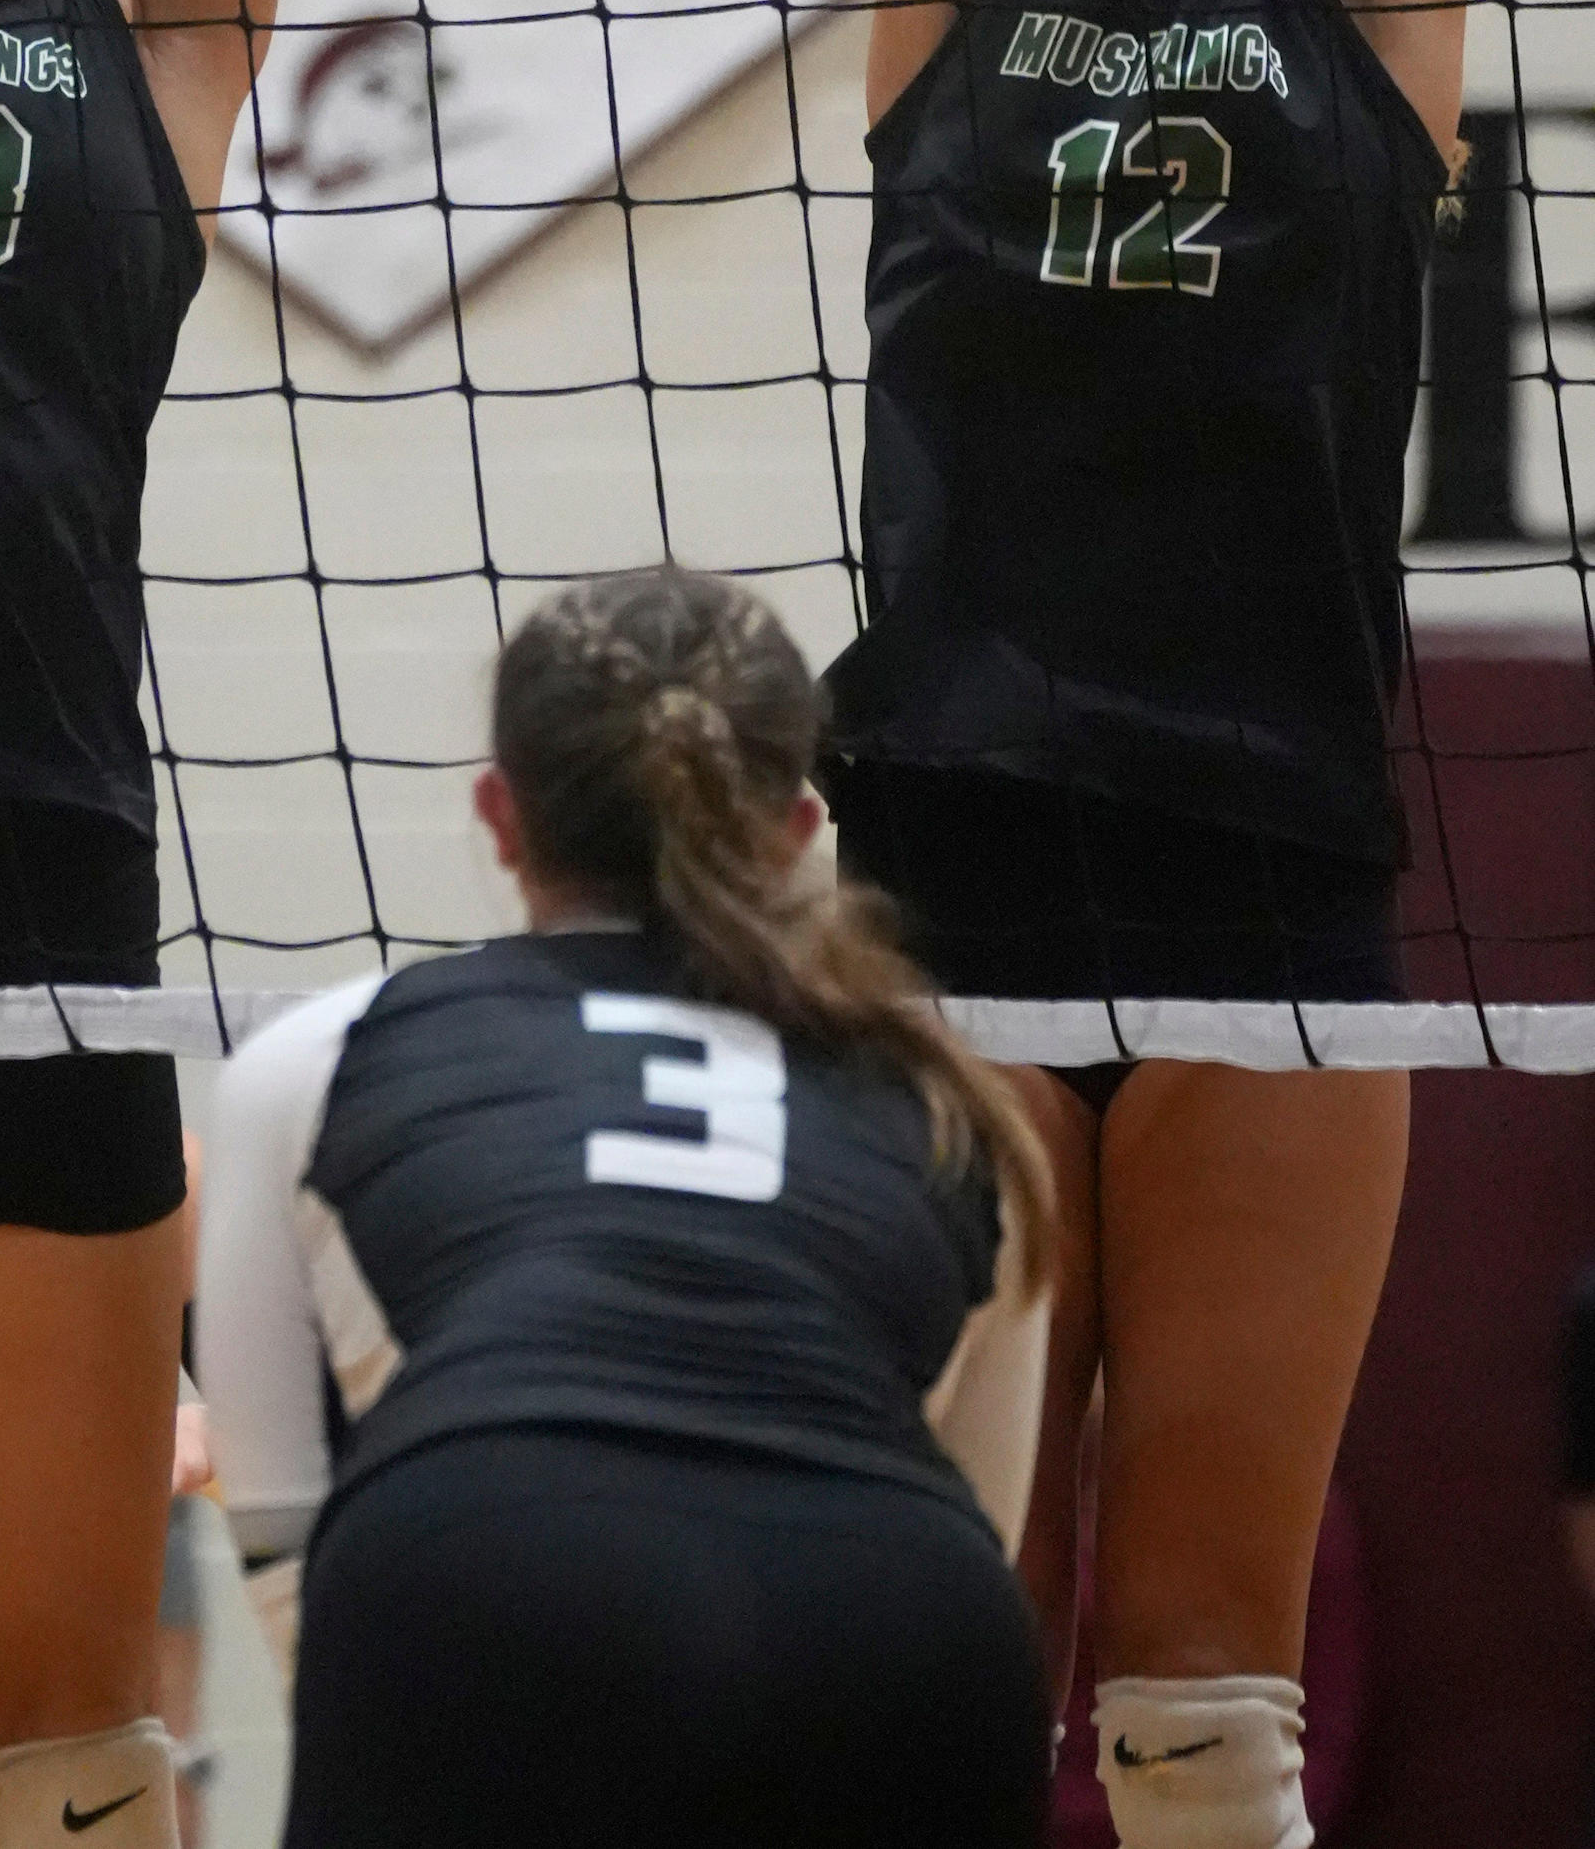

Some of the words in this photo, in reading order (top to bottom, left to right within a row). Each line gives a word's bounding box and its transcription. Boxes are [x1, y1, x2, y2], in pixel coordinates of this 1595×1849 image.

[999, 11, 1289, 100] MUSTANGS
[1040, 118, 1233, 298] 12
[580, 991, 788, 1203] 3
